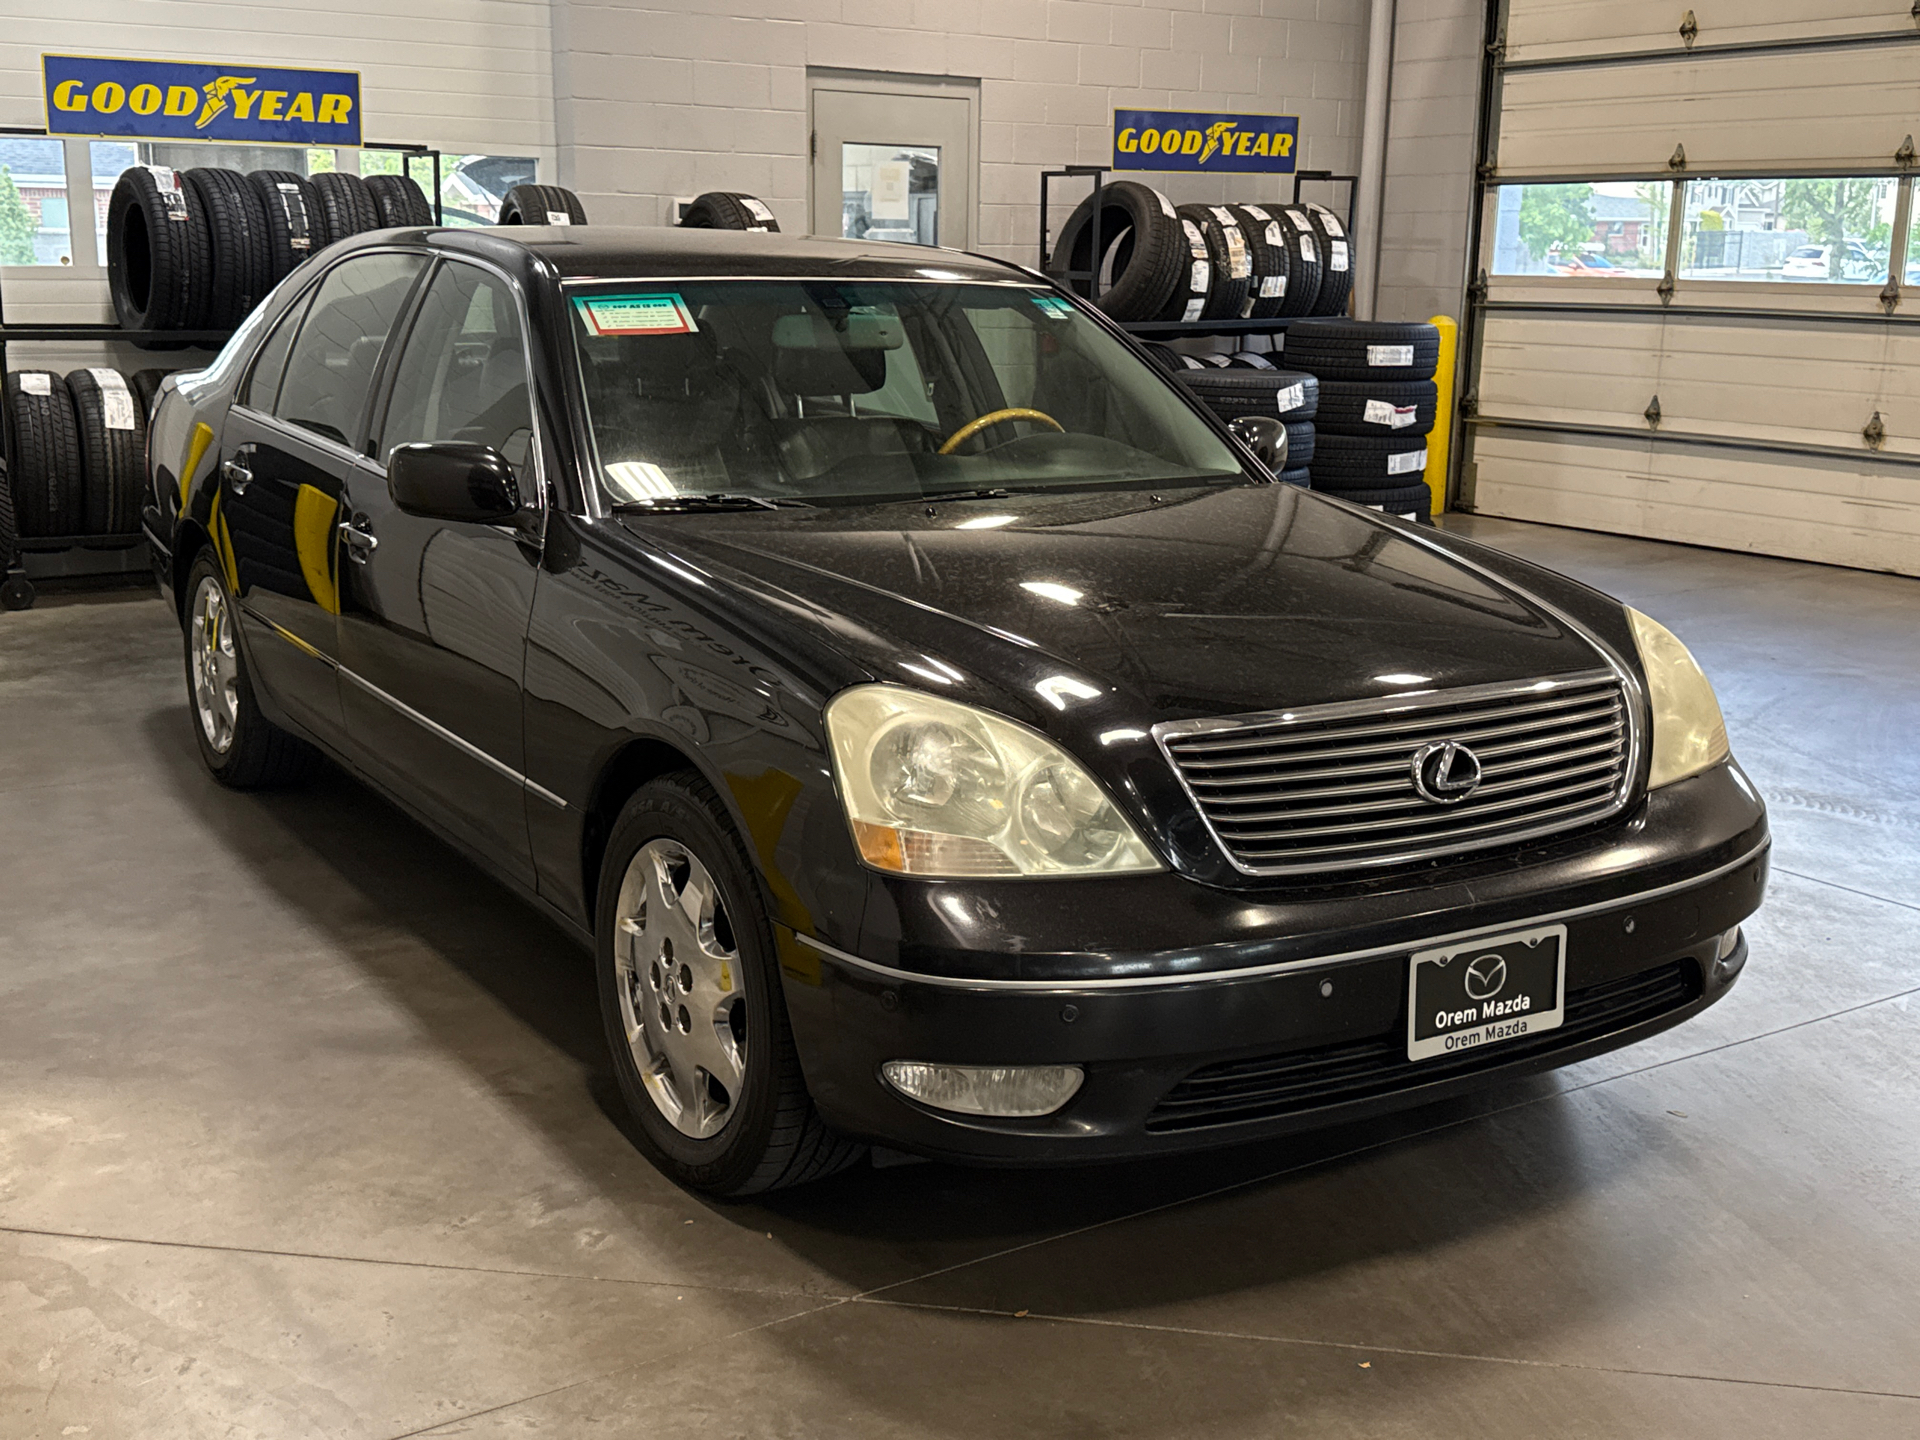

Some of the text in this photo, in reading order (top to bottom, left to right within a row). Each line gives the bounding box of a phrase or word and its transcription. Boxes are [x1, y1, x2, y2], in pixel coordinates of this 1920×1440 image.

[1435, 993, 1531, 1029] Orem Mazda
[1444, 1019, 1528, 1050] Orem Mazda
